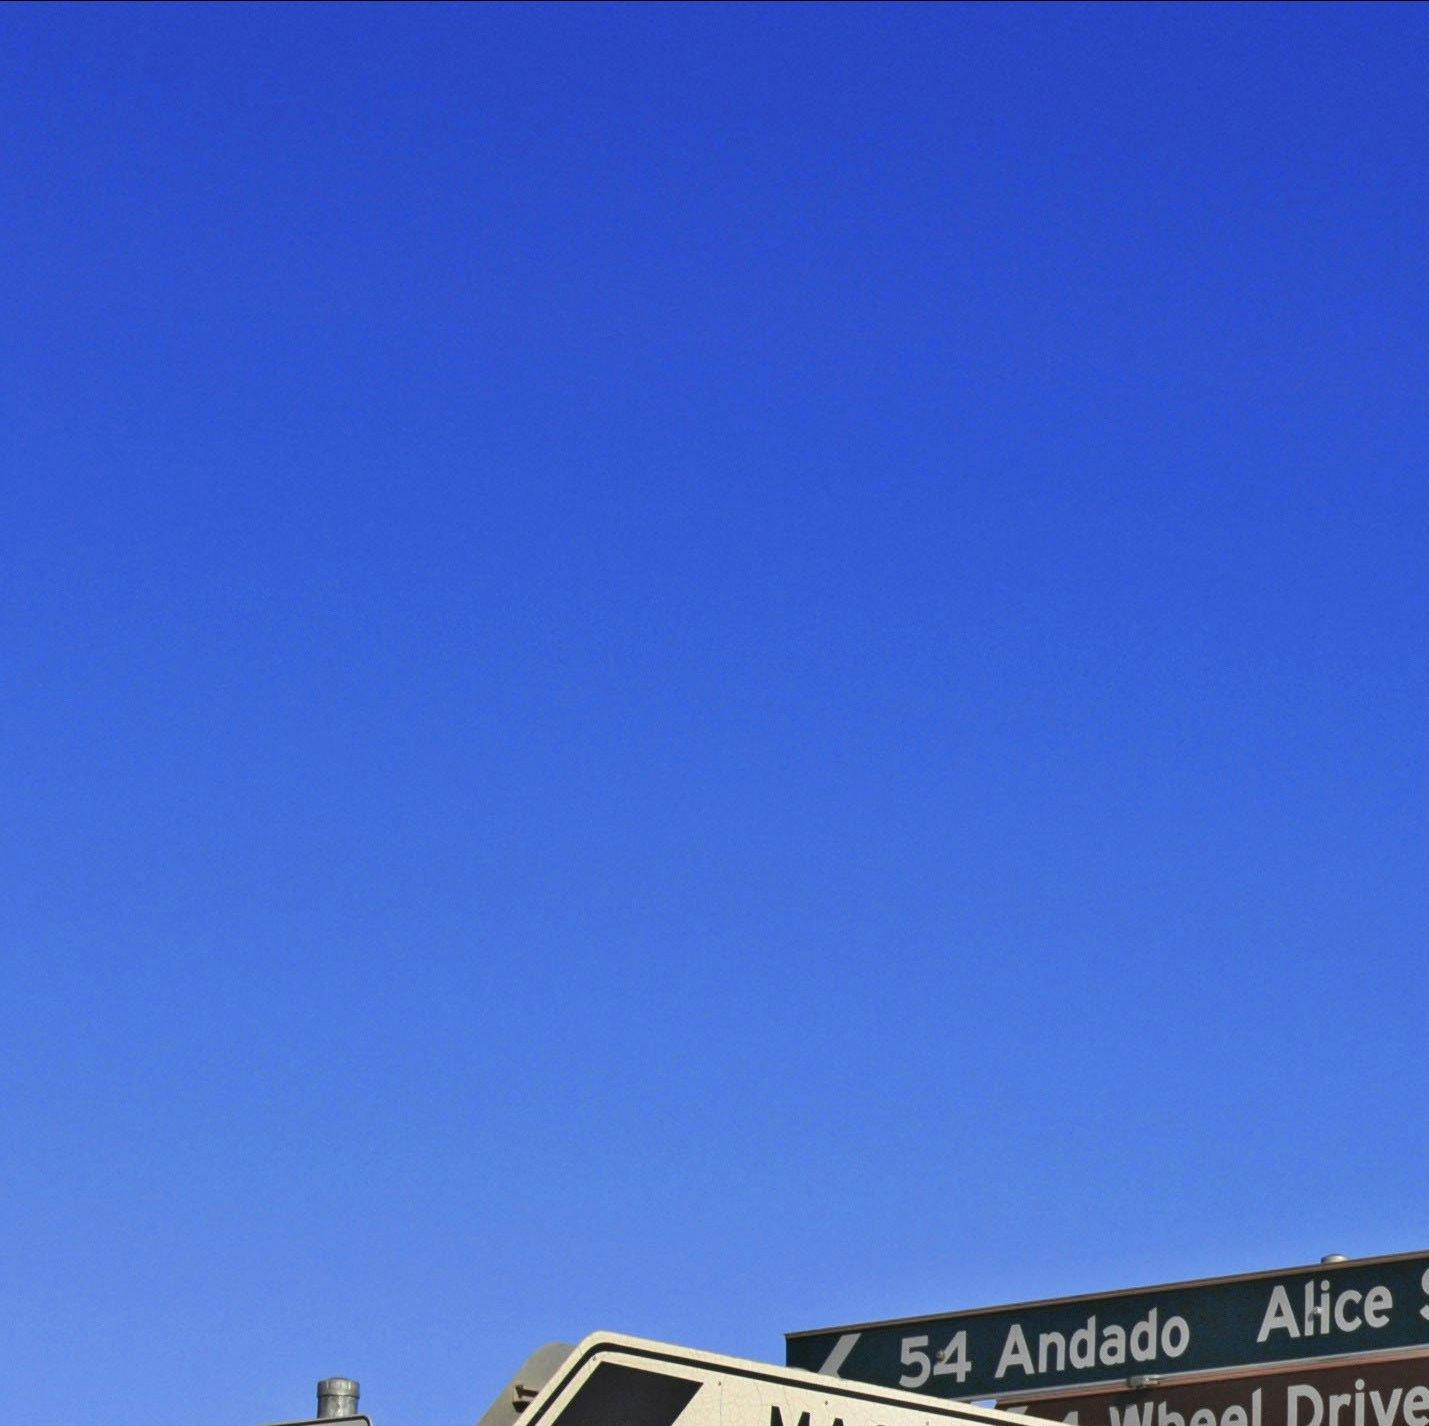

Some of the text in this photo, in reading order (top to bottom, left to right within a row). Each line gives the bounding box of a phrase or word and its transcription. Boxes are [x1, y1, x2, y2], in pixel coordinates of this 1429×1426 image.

[899, 1329, 972, 1389] 54
[994, 1306, 1191, 1380] Andado
[1256, 1279, 1393, 1343] Alice
